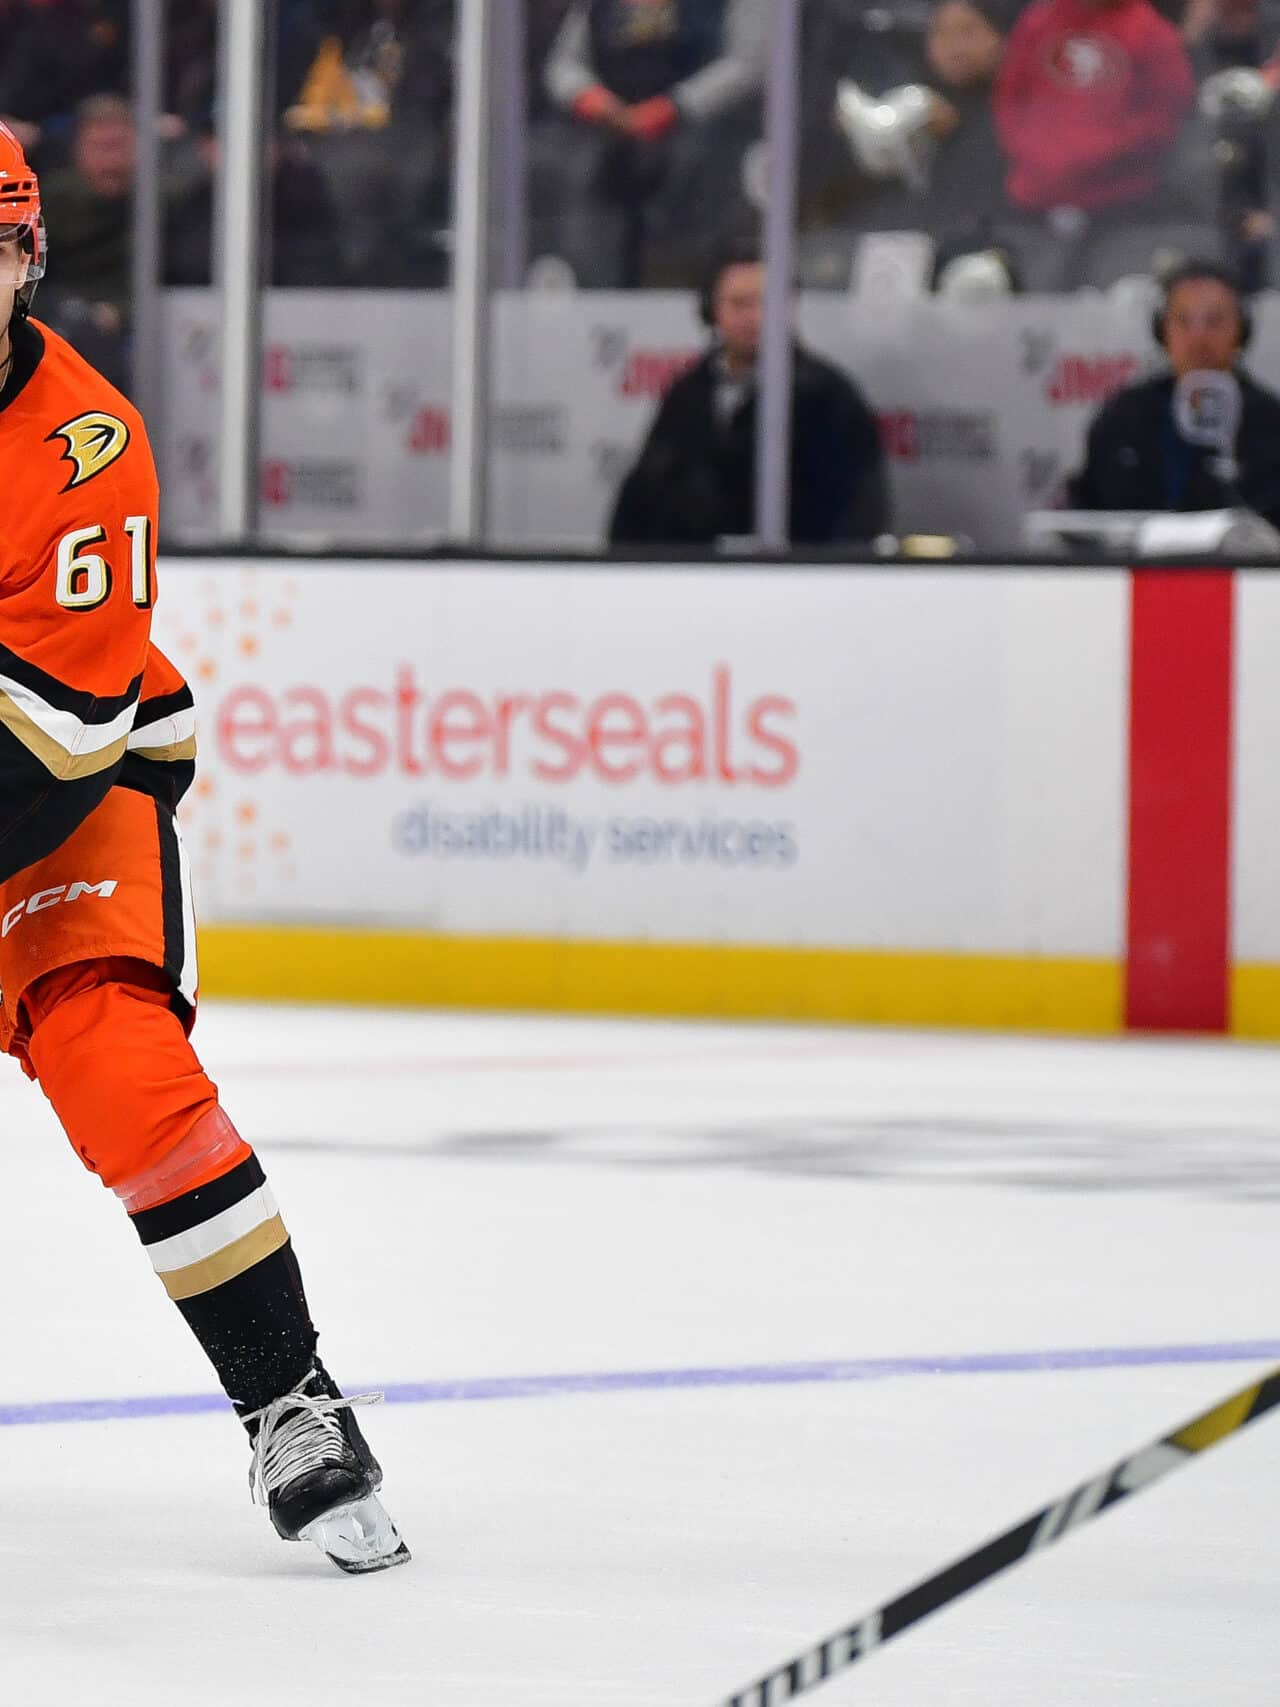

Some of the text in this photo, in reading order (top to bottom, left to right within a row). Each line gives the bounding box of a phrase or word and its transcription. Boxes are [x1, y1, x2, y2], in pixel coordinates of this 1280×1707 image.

[55, 515, 152, 612] 61
[217, 663, 798, 788] easterseals
[392, 804, 798, 873] disability services
[1, 880, 118, 938] CCM
